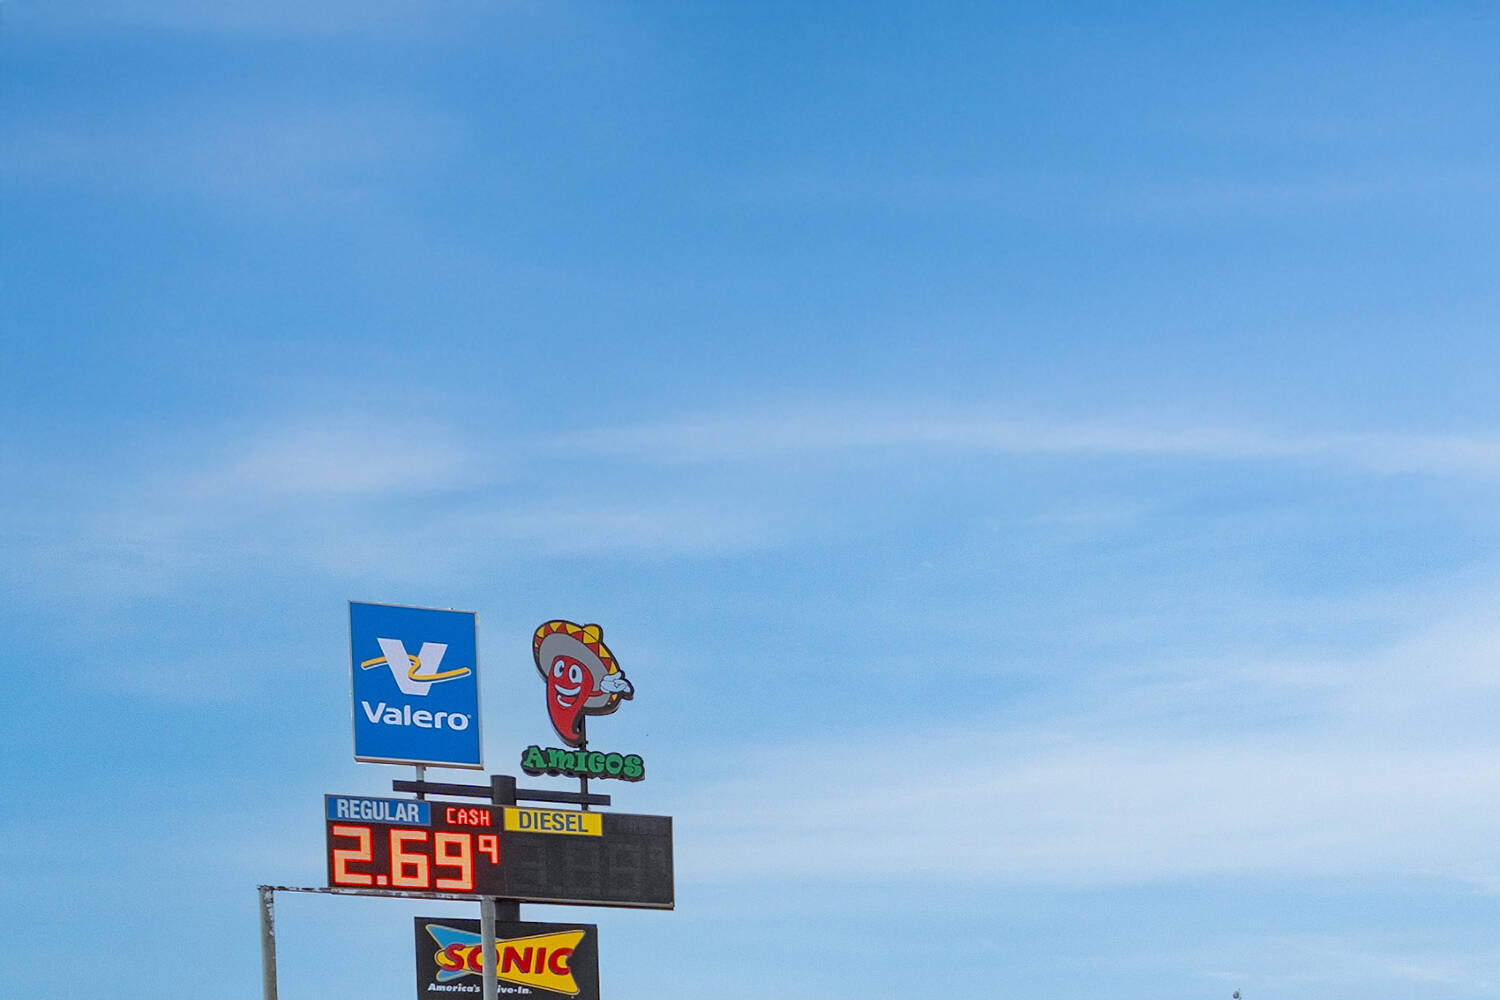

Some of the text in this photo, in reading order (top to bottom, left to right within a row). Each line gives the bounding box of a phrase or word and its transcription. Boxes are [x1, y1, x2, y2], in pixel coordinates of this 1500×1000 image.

[361, 701, 469, 731] Valero
[337, 799, 420, 823] REGULAR
[446, 807, 491, 827] CASH
[518, 811, 589, 833] DIESEL
[443, 943, 574, 976] SONIC
[427, 982, 481, 993] America's
